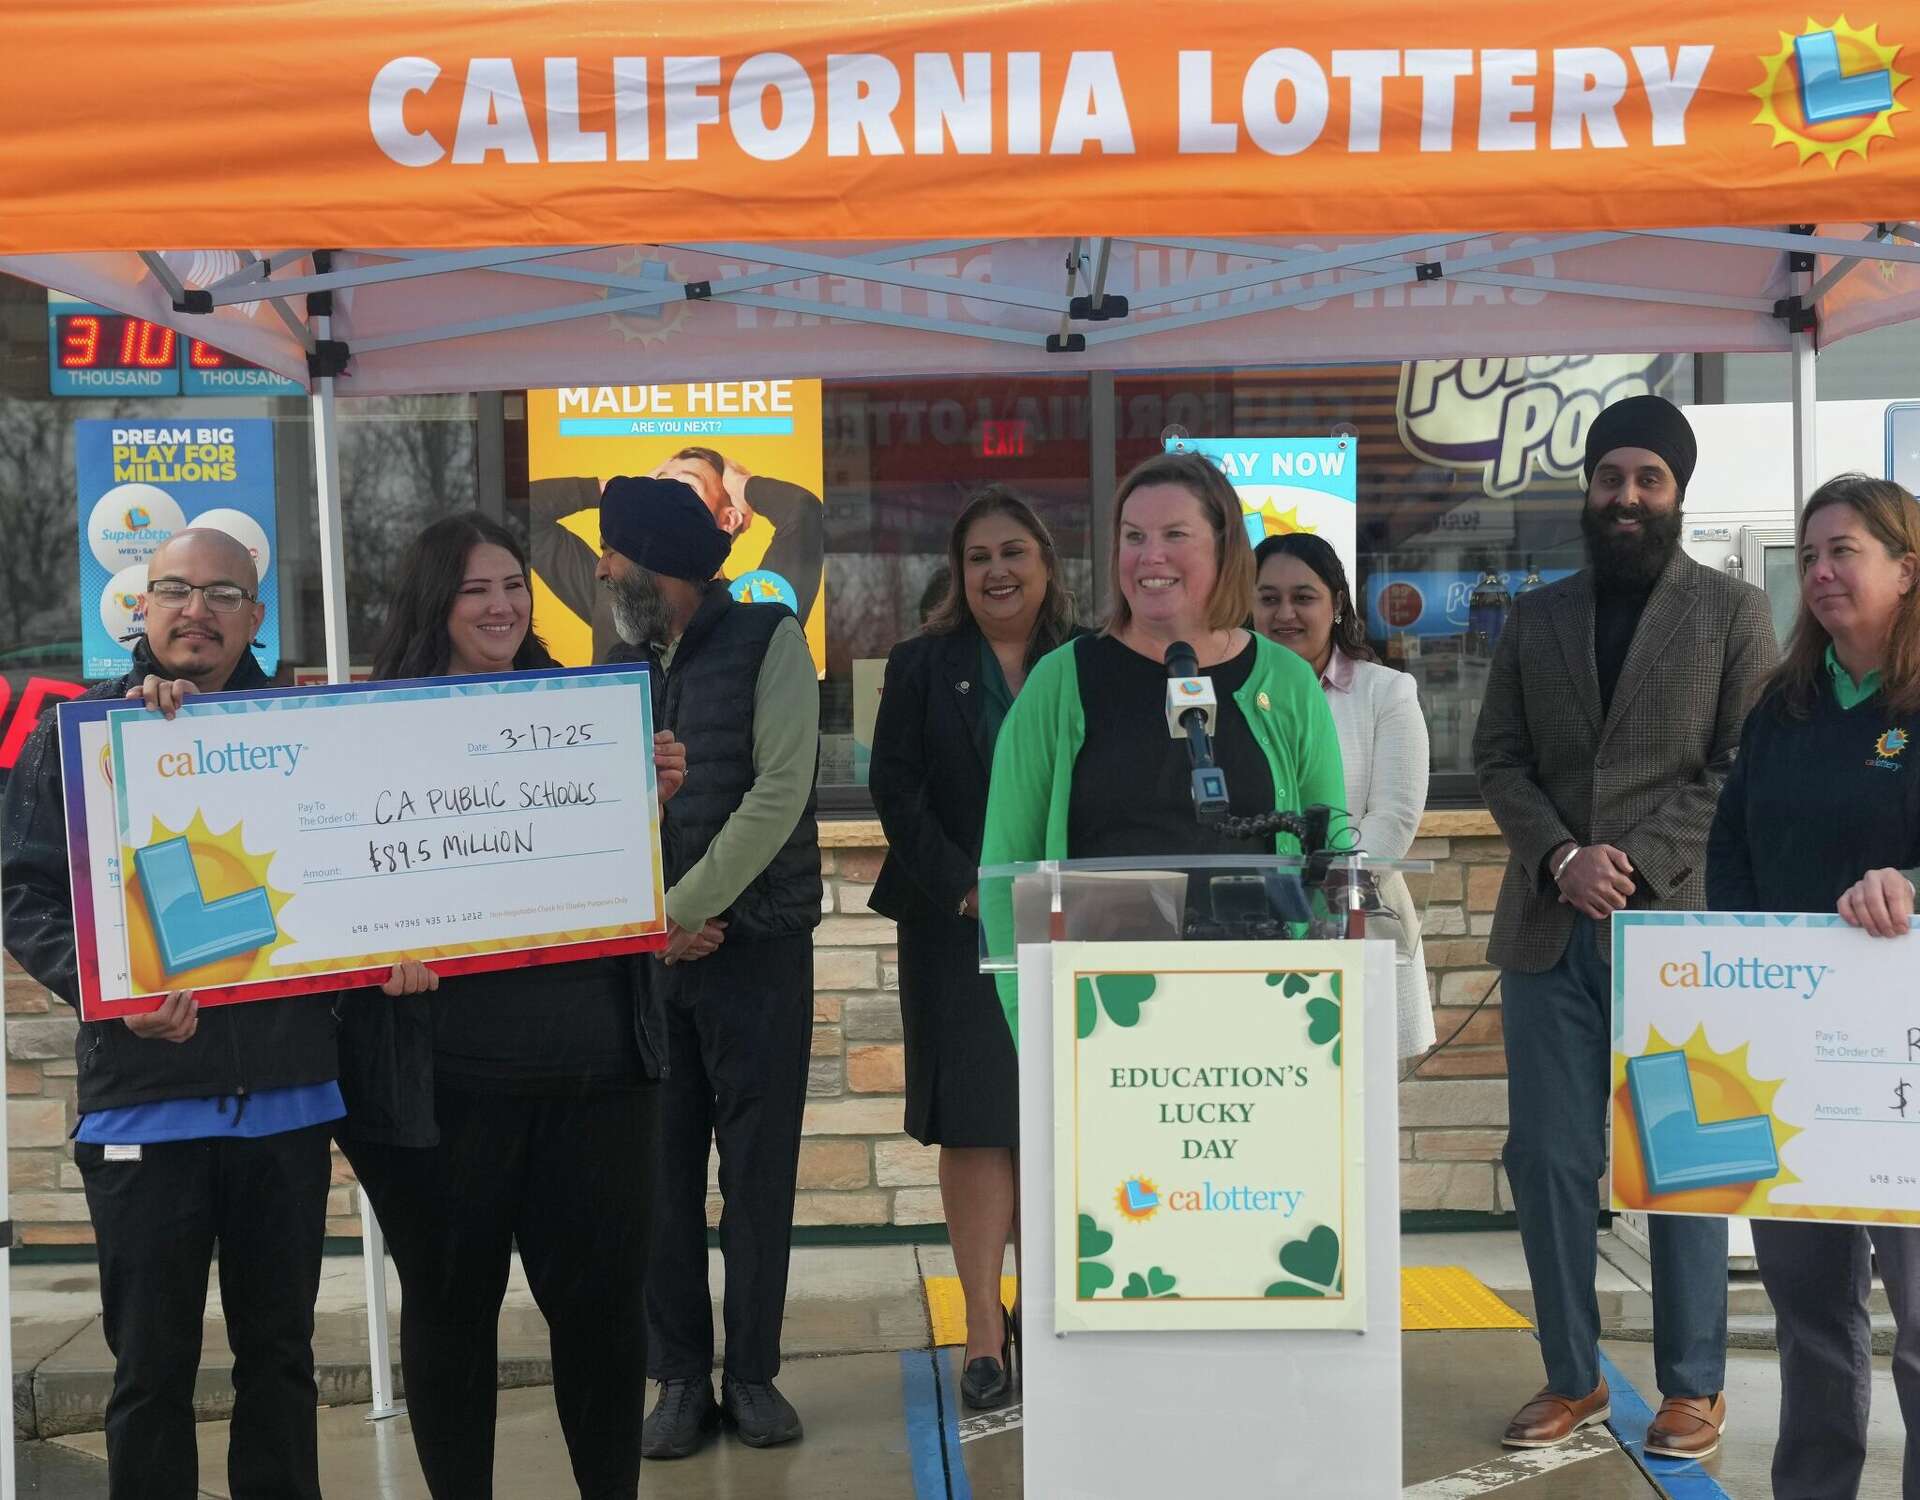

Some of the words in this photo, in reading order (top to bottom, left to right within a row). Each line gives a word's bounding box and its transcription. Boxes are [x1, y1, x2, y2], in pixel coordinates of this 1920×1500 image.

[369, 51, 1134, 167] CALIFORNIA
[1178, 45, 1714, 156] LOTTERY
[68, 371, 162, 385] THOUSAND
[558, 385, 673, 413] MADE
[688, 380, 793, 412] HERE
[112, 428, 190, 444] DREAM
[197, 428, 234, 443] BIG
[630, 422, 655, 433] ARE
[658, 421, 681, 433] YOU
[684, 421, 722, 433] NEXT?
[982, 421, 1026, 457] EXIT
[113, 445, 177, 463] PLAY
[184, 445, 236, 462] FOR
[114, 463, 237, 482] MILLIONS
[1220, 453, 1260, 477] AY
[1271, 452, 1346, 477] NOW
[500, 723, 593, 750] 3-17-25
[157, 739, 303, 778] calottery
[299, 803, 315, 813] Pay
[316, 801, 326, 811] To
[375, 790, 416, 824] CA
[519, 780, 597, 808] SCHOOLS
[299, 816, 315, 826] The
[317, 814, 343, 825] Order
[108, 858, 119, 868] Pa
[369, 840, 431, 873] $89.5
[109, 872, 120, 882] Th
[1659, 950, 1828, 1000] calottery
[1815, 1030, 1834, 1043] Pay
[1836, 1031, 1849, 1041] To
[1815, 1046, 1836, 1056] The
[1837, 1046, 1869, 1057] Order
[1110, 1065, 1308, 1088] EDUCATION'S
[1159, 1103, 1255, 1124] LUCKY
[1181, 1139, 1239, 1159] DAY
[1169, 1181, 1303, 1218] calottery
